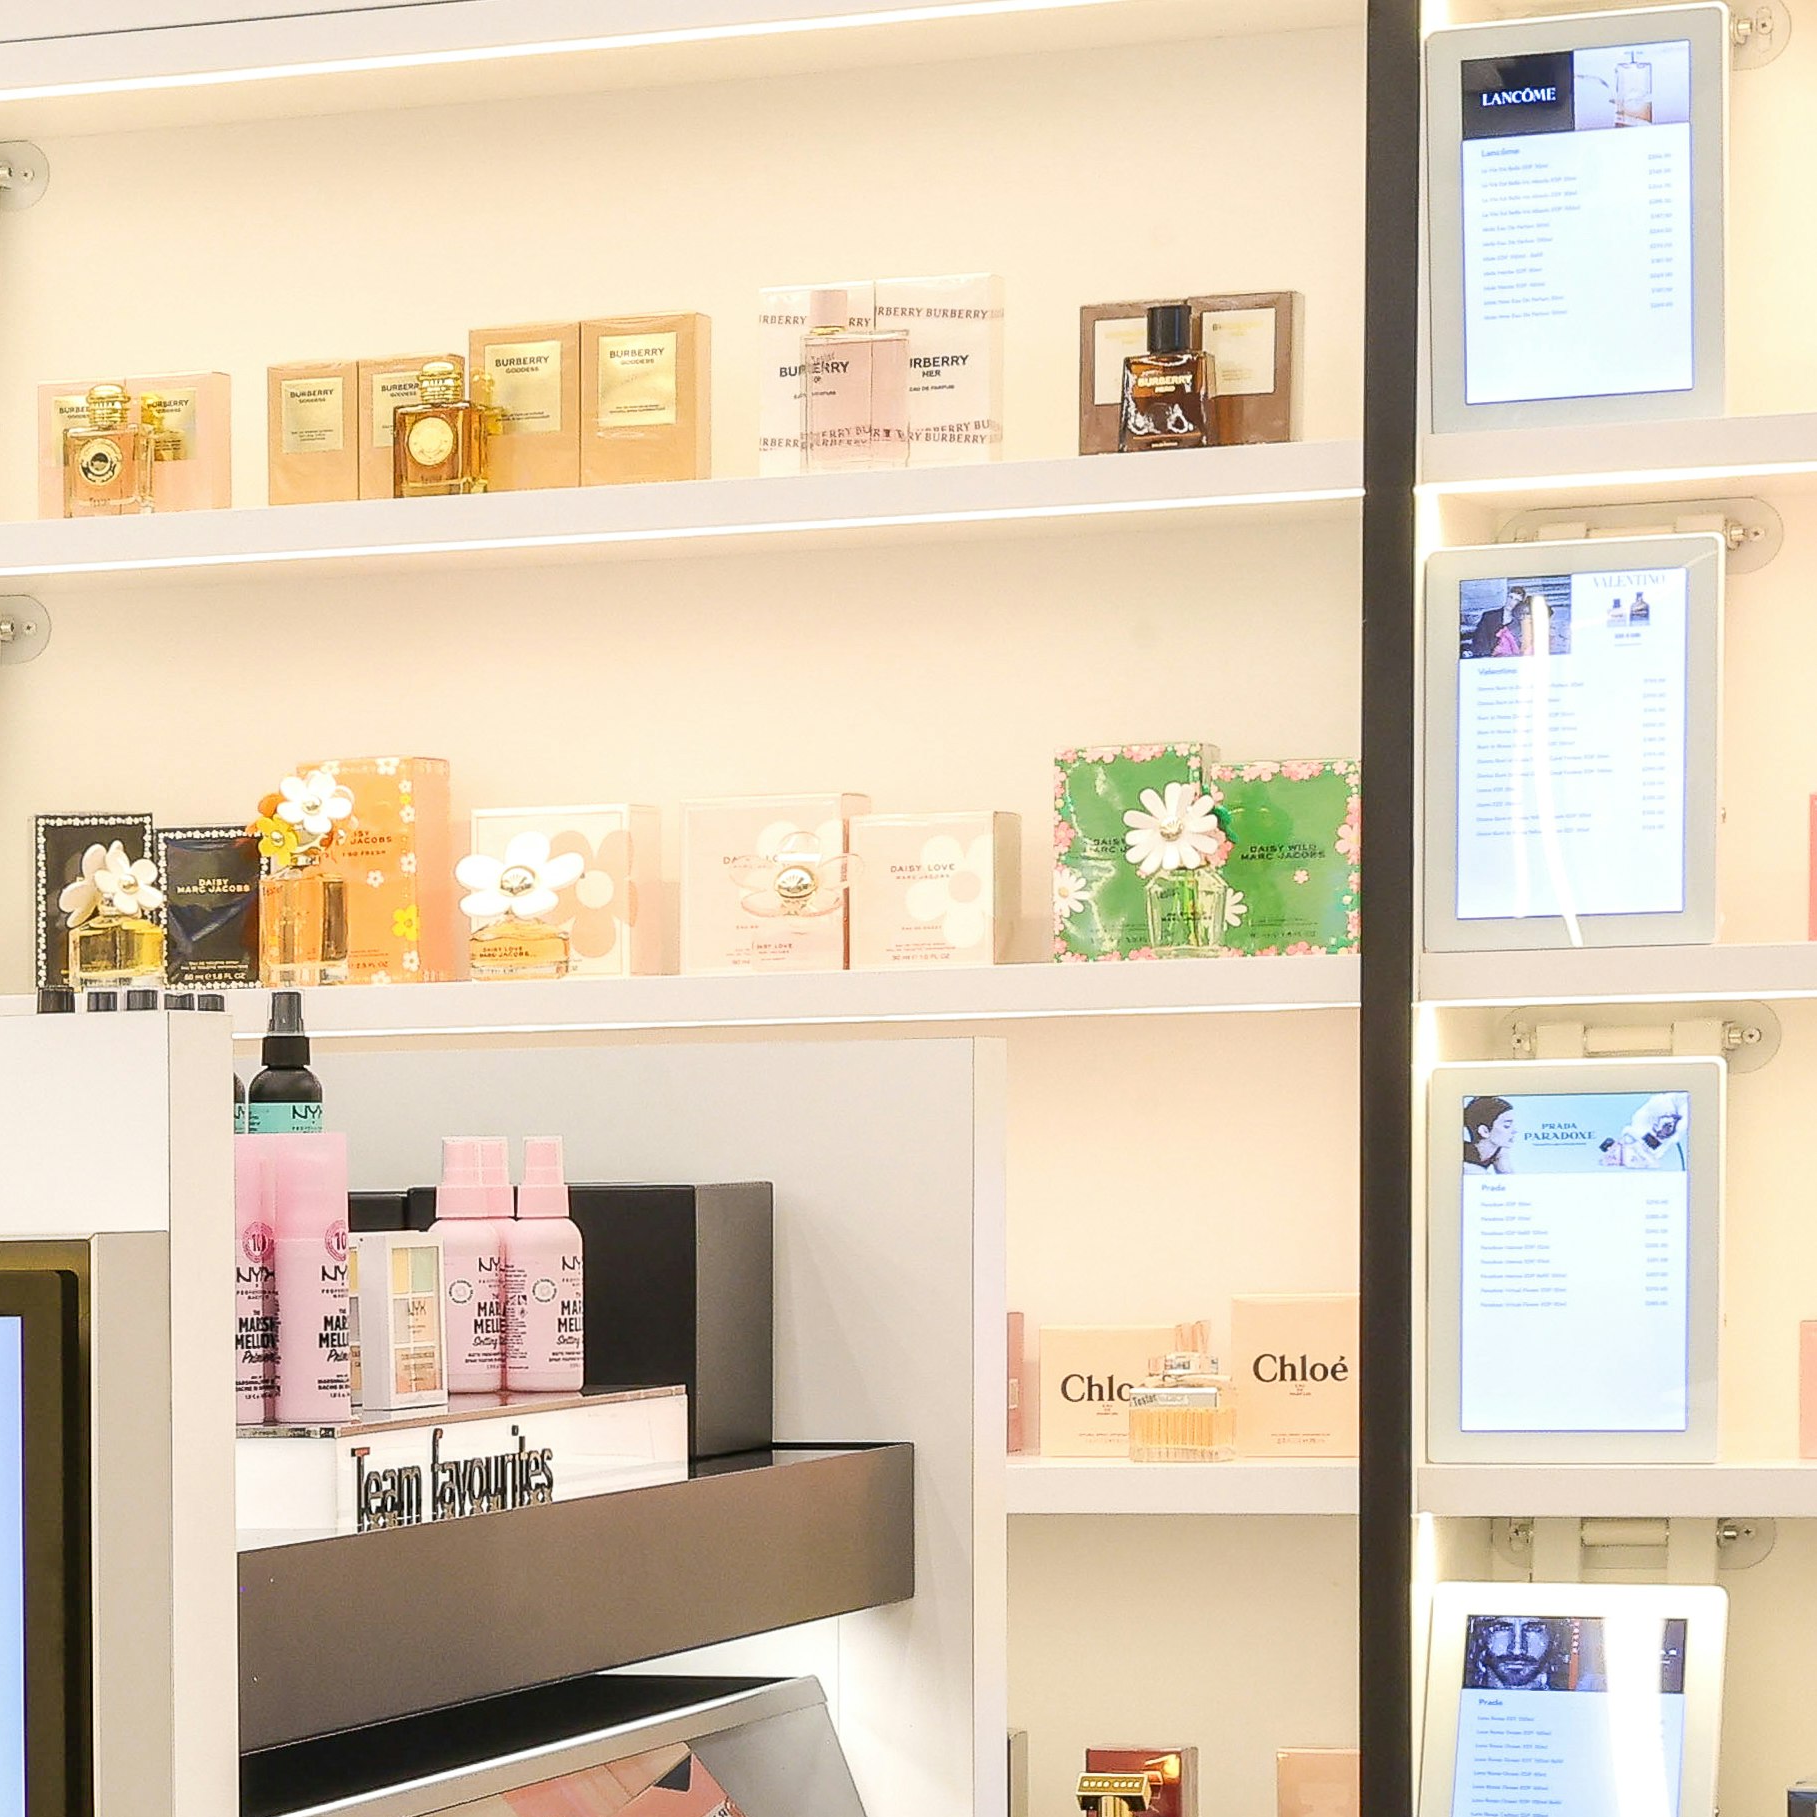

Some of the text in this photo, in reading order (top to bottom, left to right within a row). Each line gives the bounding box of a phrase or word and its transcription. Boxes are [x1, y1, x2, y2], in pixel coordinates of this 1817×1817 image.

[1482, 87, 1556, 106] LANCÔME
[608, 346, 665, 361] BURBERRY
[494, 354, 551, 369] BURBERRY
[1137, 374, 1194, 388] BURBERRY
[289, 386, 335, 402] BURBERRY
[1593, 574, 1666, 589] VALENTINO
[1241, 848, 1326, 862] MARC JACOBS
[1250, 843, 1285, 854] DAISY
[890, 862, 956, 875] DAISY LOVE
[177, 883, 250, 895] MARC JACOBS
[198, 877, 230, 888] DAISY
[1541, 1122, 1577, 1130] PRADA
[1524, 1130, 1595, 1141] PARADOXE
[1481, 1183, 1506, 1192] Prada
[1253, 1354, 1349, 1383] Chloé
[1060, 1374, 1133, 1403] Chlo
[351, 1425, 554, 1524] Team favourites
[1478, 1698, 1504, 1707] Prada
